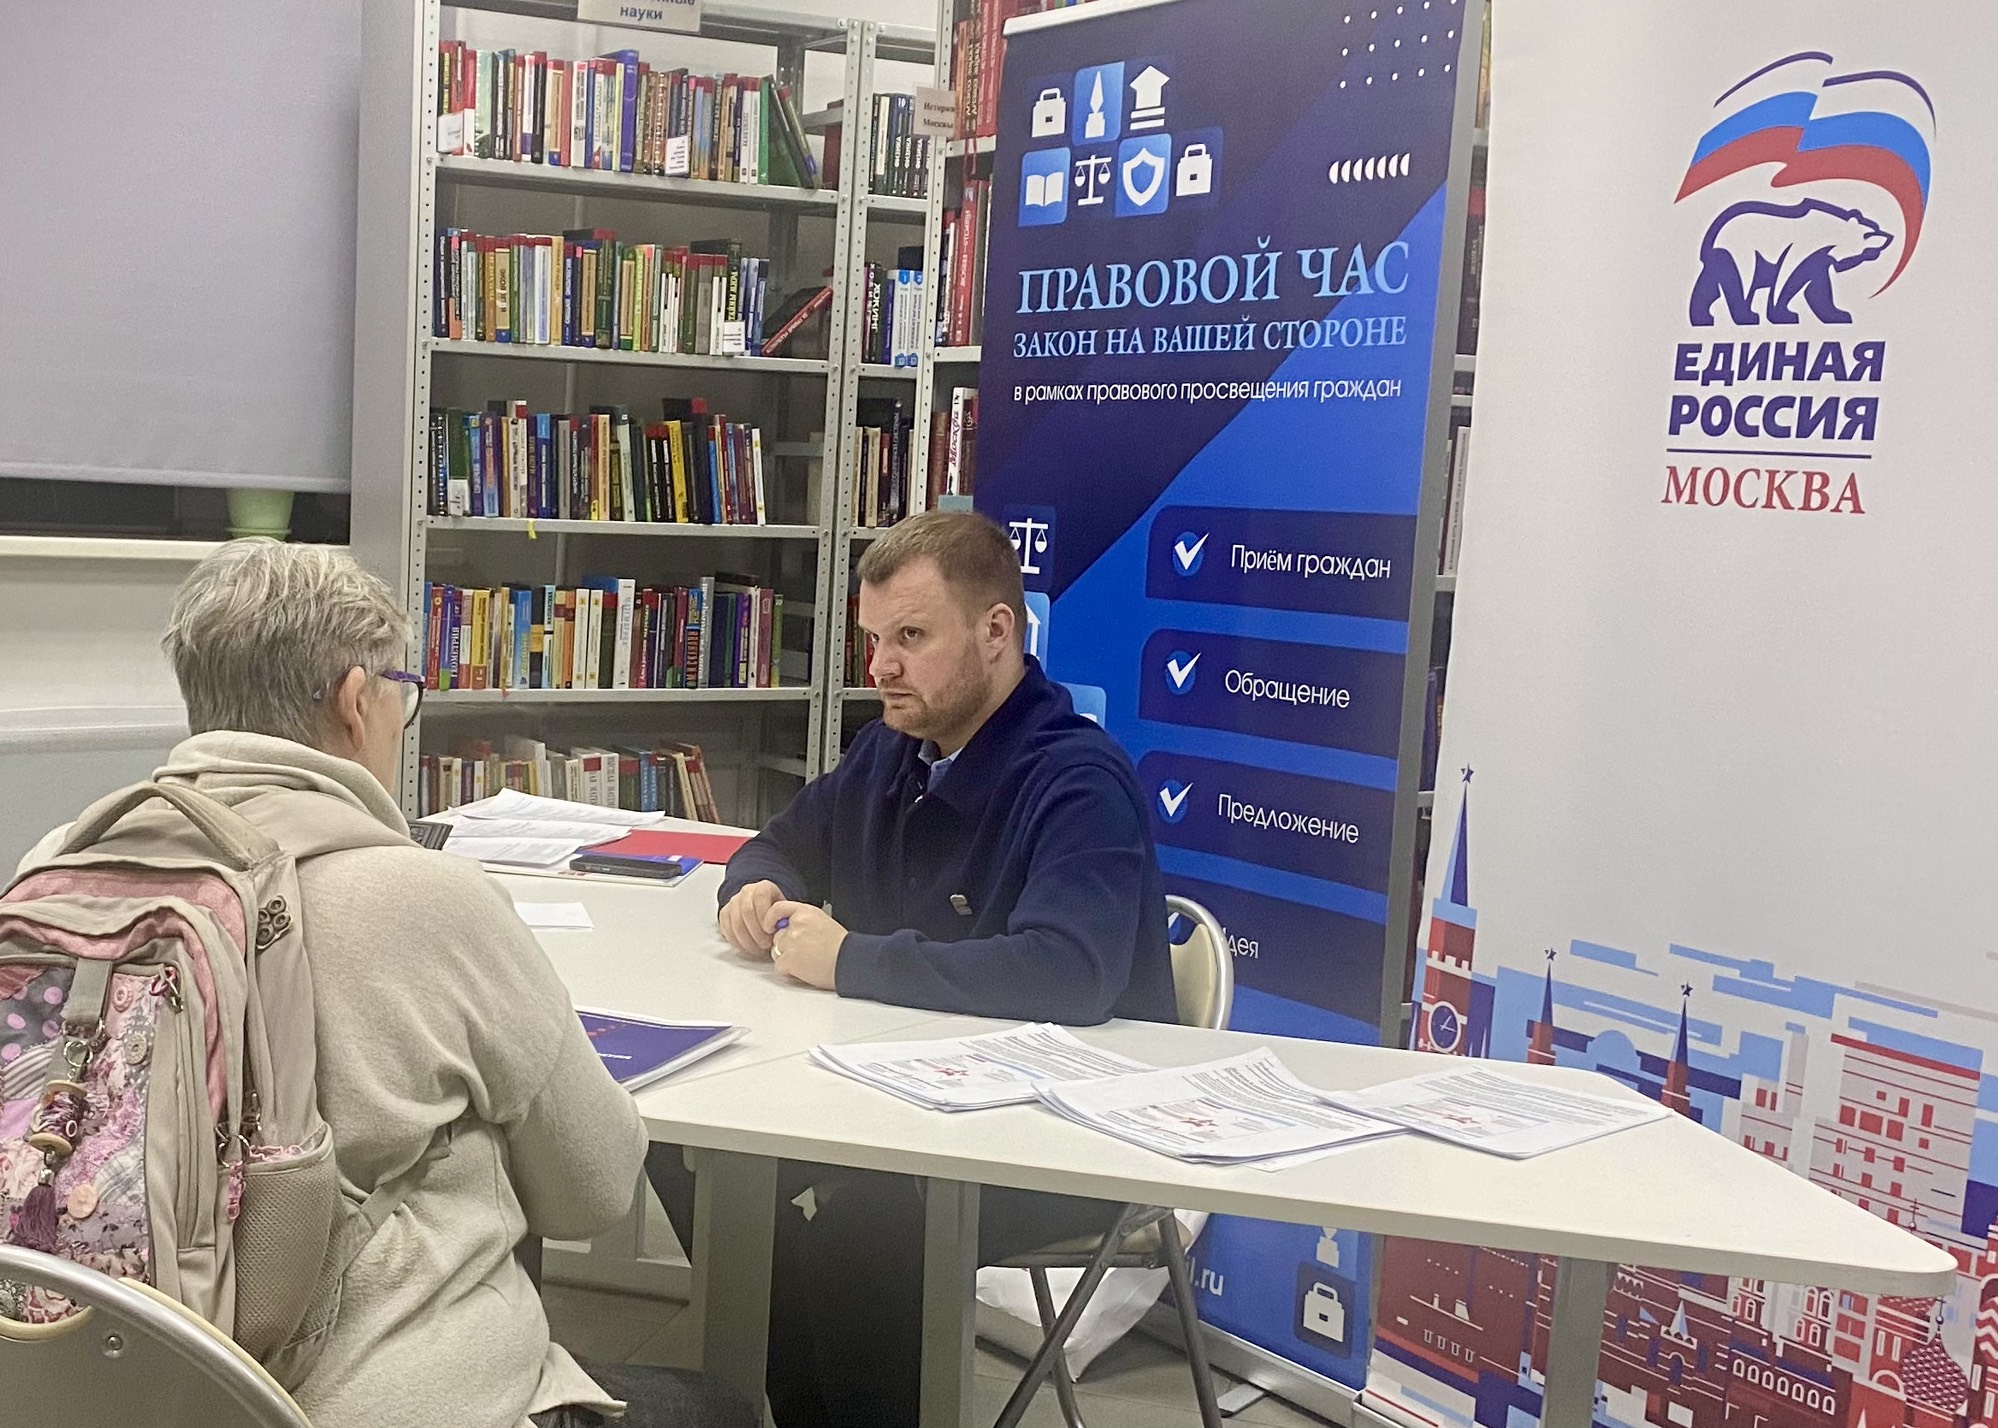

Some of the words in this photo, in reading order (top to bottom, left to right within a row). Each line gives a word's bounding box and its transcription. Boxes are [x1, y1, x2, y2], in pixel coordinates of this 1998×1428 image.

[620, 6, 663, 21] науки
[922, 117, 954, 129] Москвы
[923, 101, 955, 114] История
[894, 135, 902, 168] ФИЗИКА
[904, 136, 912, 169] ФИЗИКА
[1015, 234, 1283, 314] ПРАВОВОЙ
[1296, 240, 1410, 298] ЧАС
[872, 283, 881, 331] ХОКИНГ
[1013, 329, 1098, 358] ЗАКОН
[1104, 328, 1145, 355] НА
[1154, 313, 1257, 353] ВАШЕЙ
[1263, 316, 1408, 351] СТОРОНЕ
[1674, 341, 1886, 387] ЕДИНАЯ
[1013, 387, 1022, 400] в
[1025, 384, 1083, 403] рамках
[1086, 380, 1178, 404] правового
[1180, 379, 1310, 404] просвещения
[1313, 378, 1402, 404] граждан
[1668, 395, 1879, 441] РОССИЯ
[1661, 466, 1866, 514] МОСКВА
[1231, 544, 1292, 574] Приём
[1296, 553, 1391, 581] граждан
[450, 626, 460, 678] ГЕОМЕТРИЯ
[1225, 669, 1350, 708] Обращение
[1218, 793, 1359, 844] Предложение
[1222, 927, 1260, 959] дея
